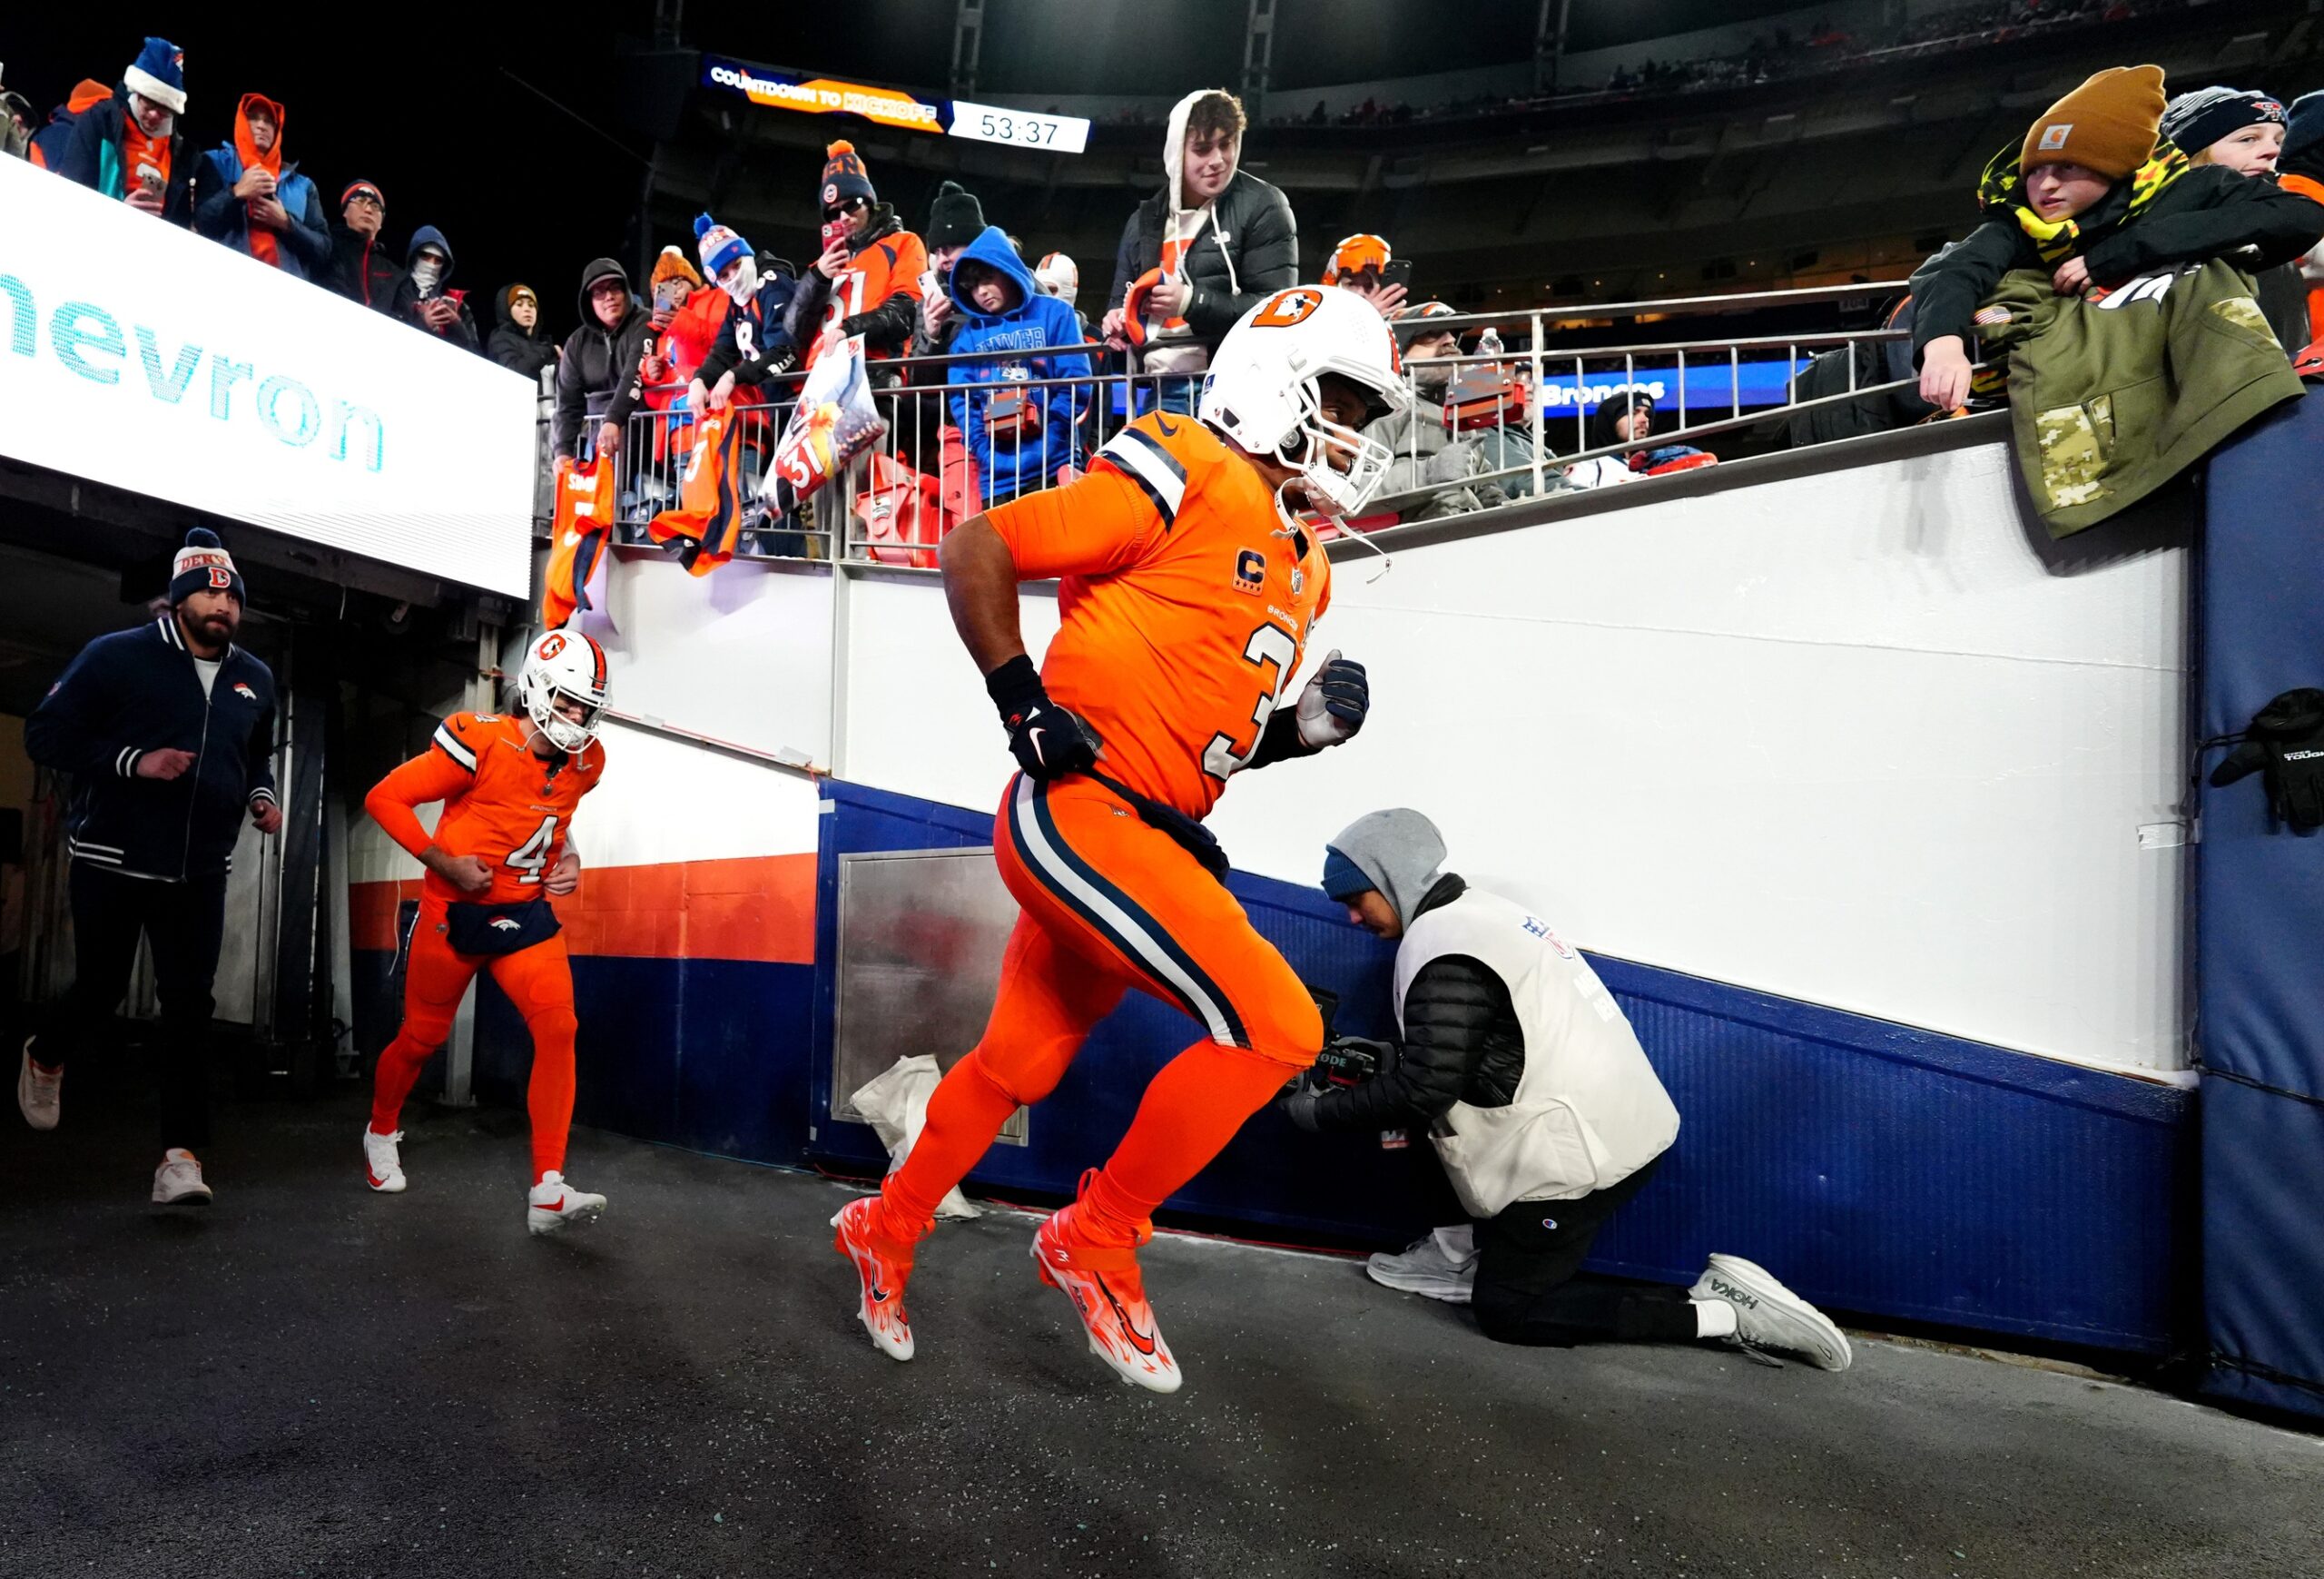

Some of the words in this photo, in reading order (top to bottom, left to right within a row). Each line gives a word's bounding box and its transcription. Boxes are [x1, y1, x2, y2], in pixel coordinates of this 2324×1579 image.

[711, 66, 817, 104] COUNTDOWN
[820, 89, 842, 107] TO
[842, 91, 938, 124] KICKOFF
[981, 114, 1059, 145] 53:37
[783, 437, 824, 489] 31
[1236, 549, 1265, 584] C
[1201, 621, 1297, 783] 3
[505, 814, 560, 886] 4
[1316, 1053, 1348, 1068] ØDE
[1710, 1278, 1759, 1310] HOKA
